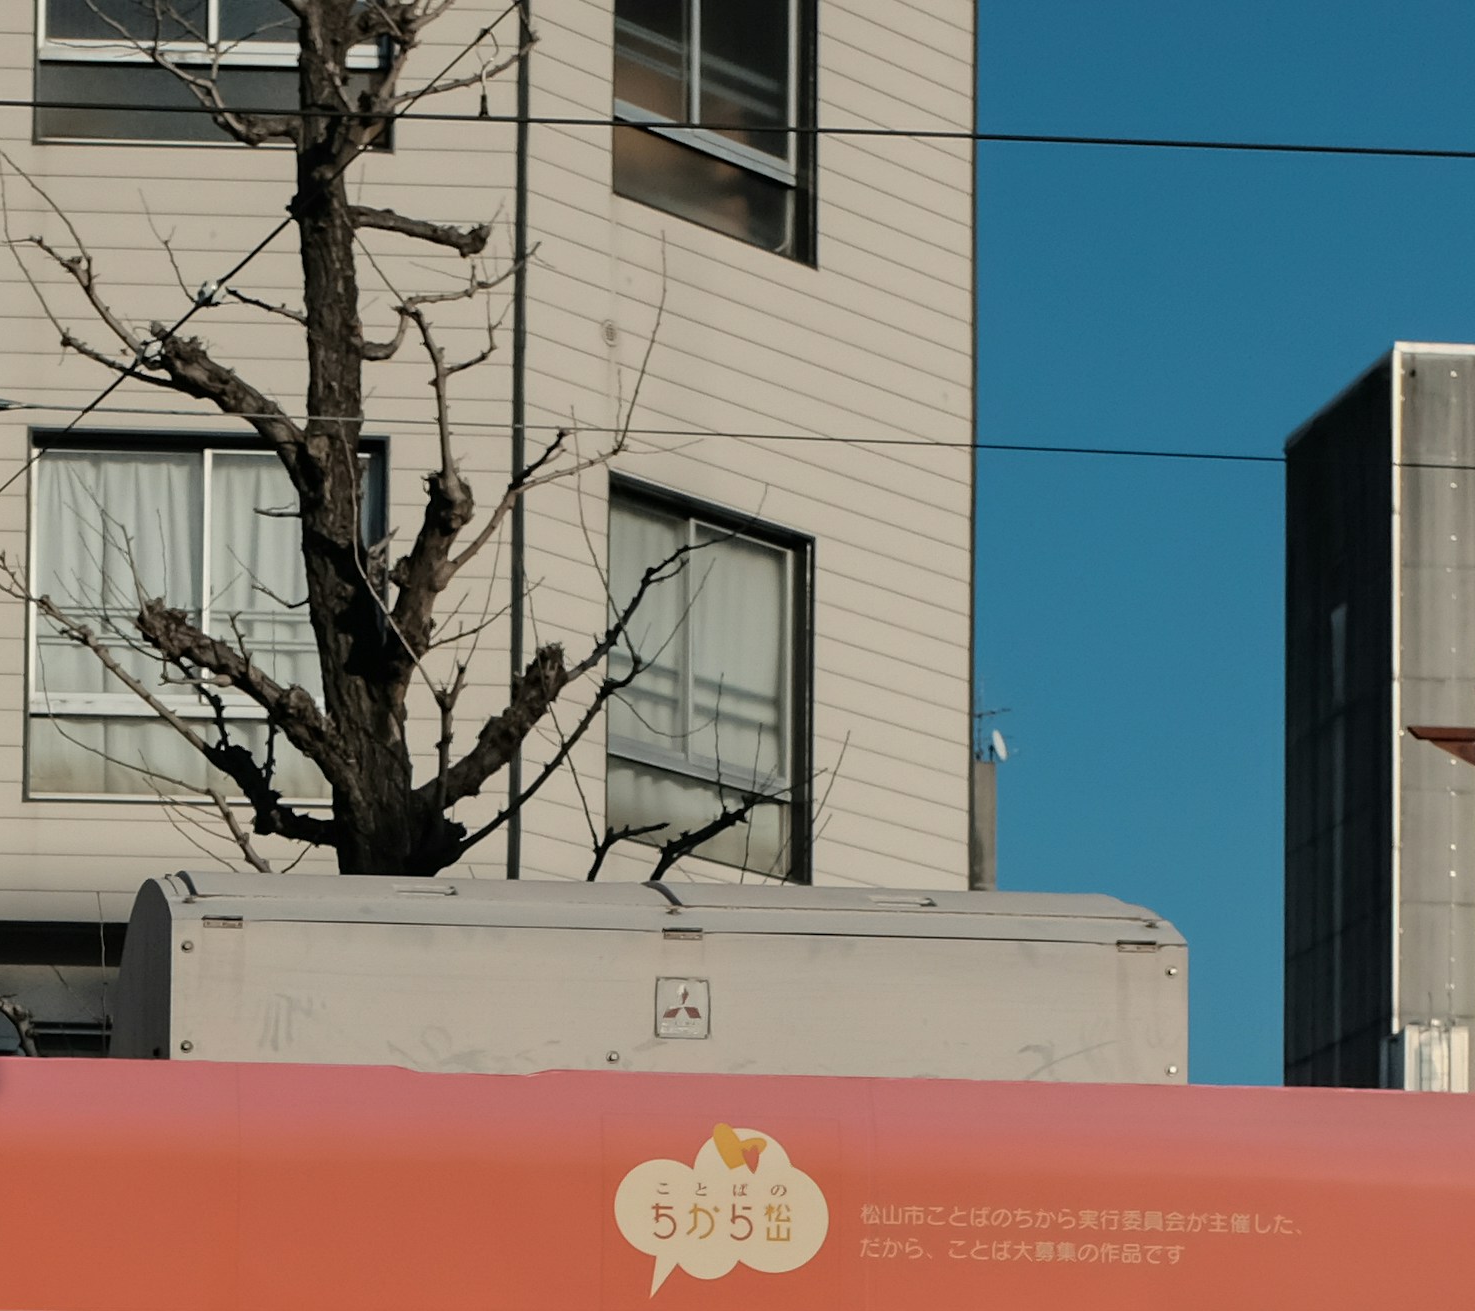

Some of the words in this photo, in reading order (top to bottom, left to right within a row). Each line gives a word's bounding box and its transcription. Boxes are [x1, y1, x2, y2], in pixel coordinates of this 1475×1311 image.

[655, 1180, 788, 1198] ことばの
[650, 1199, 755, 1242] ちから
[859, 1203, 1303, 1236] 松山市ことばのちから実行委員会が主催した、
[859, 1236, 1186, 1266] だから、ことば大募集の作品です
